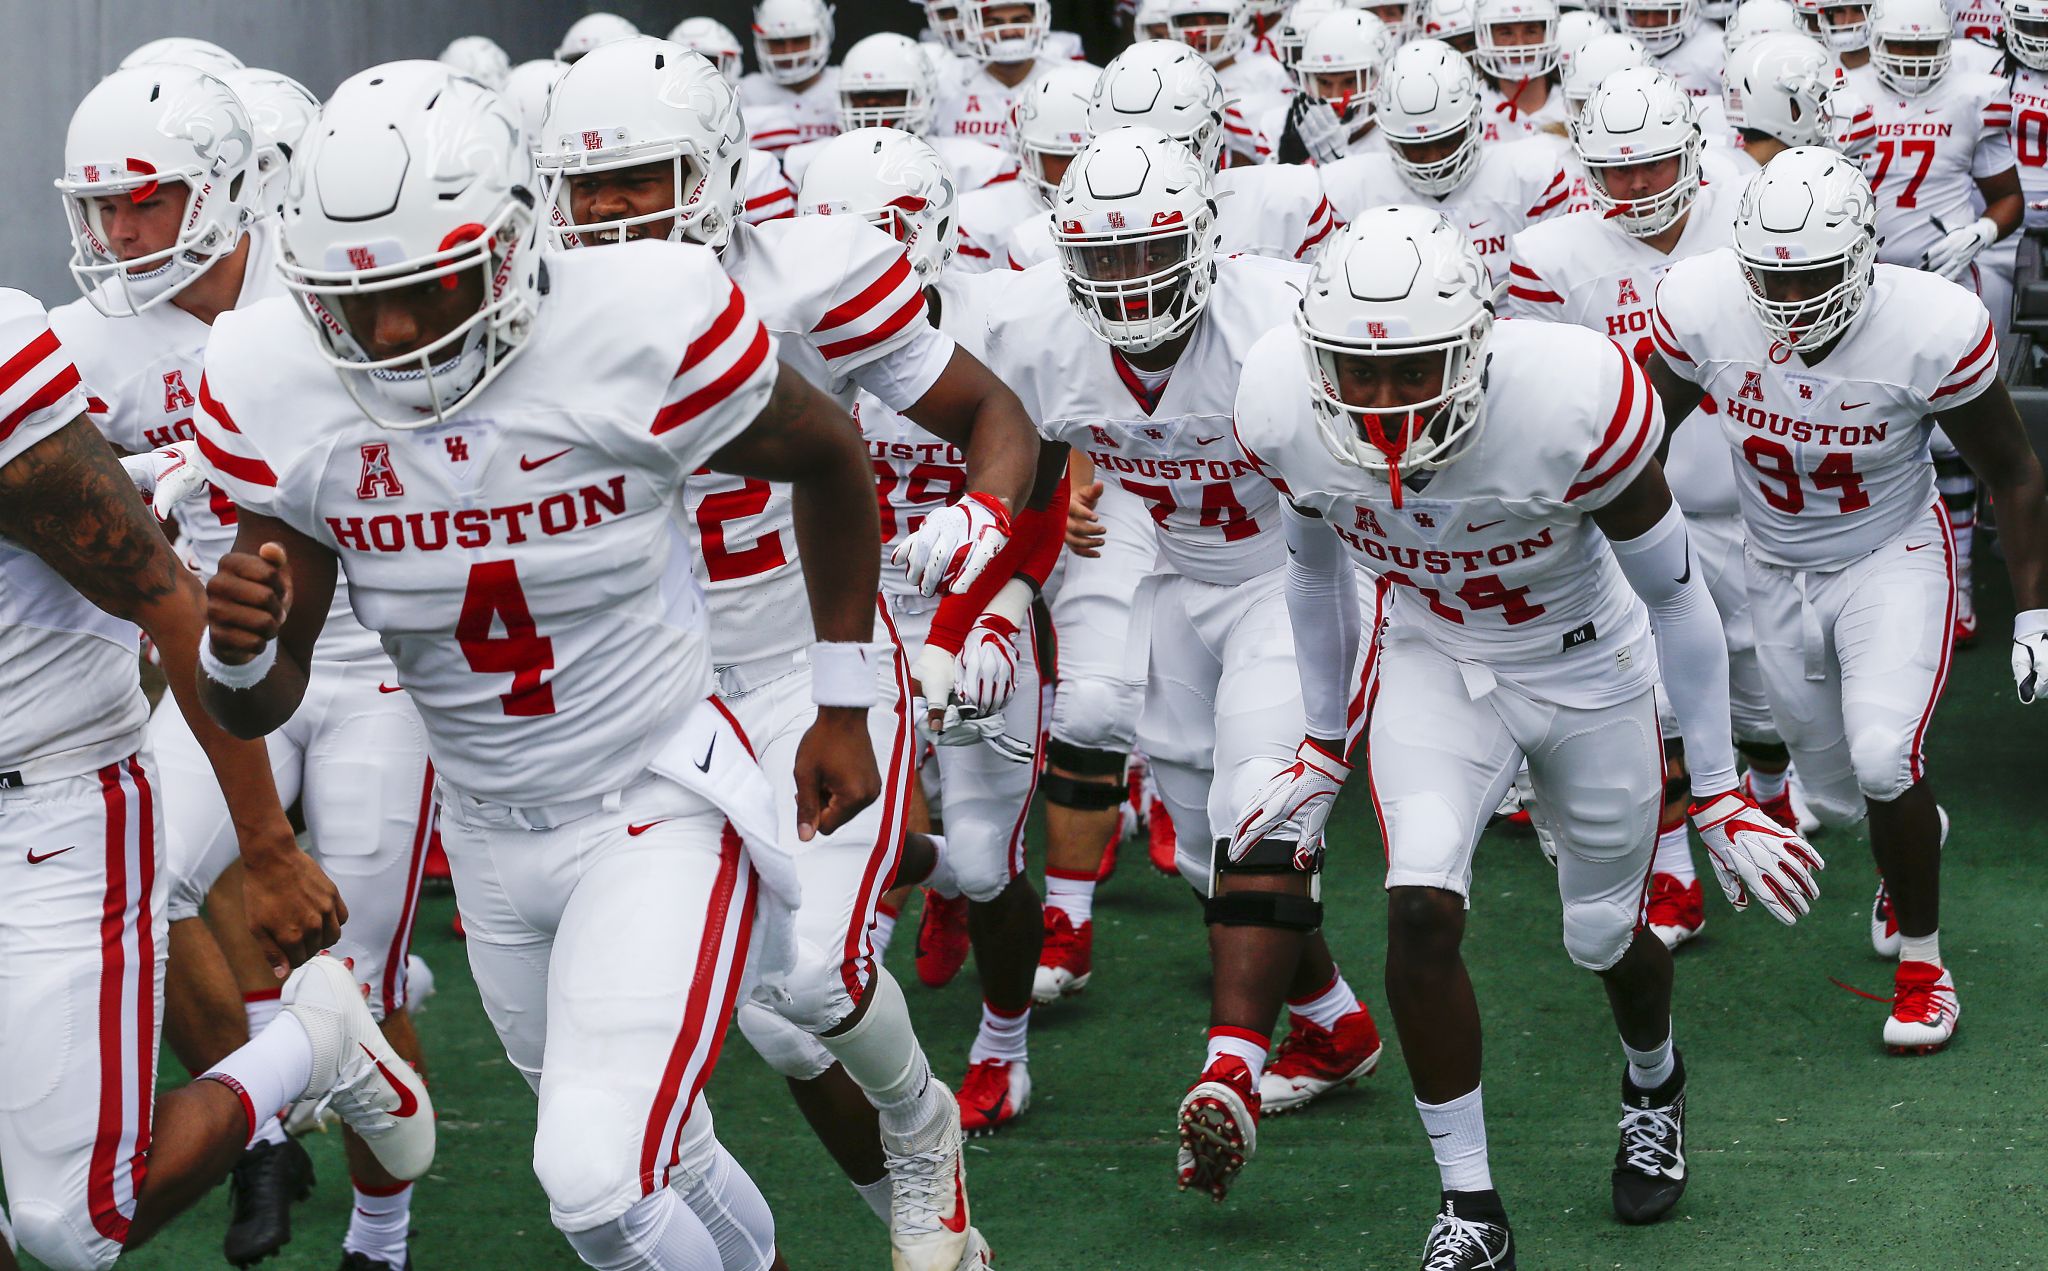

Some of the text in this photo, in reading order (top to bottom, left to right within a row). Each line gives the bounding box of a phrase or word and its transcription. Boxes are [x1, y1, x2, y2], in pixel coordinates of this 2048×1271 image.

[1876, 123, 1953, 138] USTON
[1727, 397, 1888, 446] HOUSTON
[1088, 450, 1257, 481] HOUSTON
[1743, 434, 1870, 515] 94
[325, 475, 626, 552] HOUSTON
[695, 476, 788, 582] 2
[1120, 477, 1261, 543] 74
[1333, 527, 1554, 573] HOUSTON
[455, 559, 556, 716] 4
